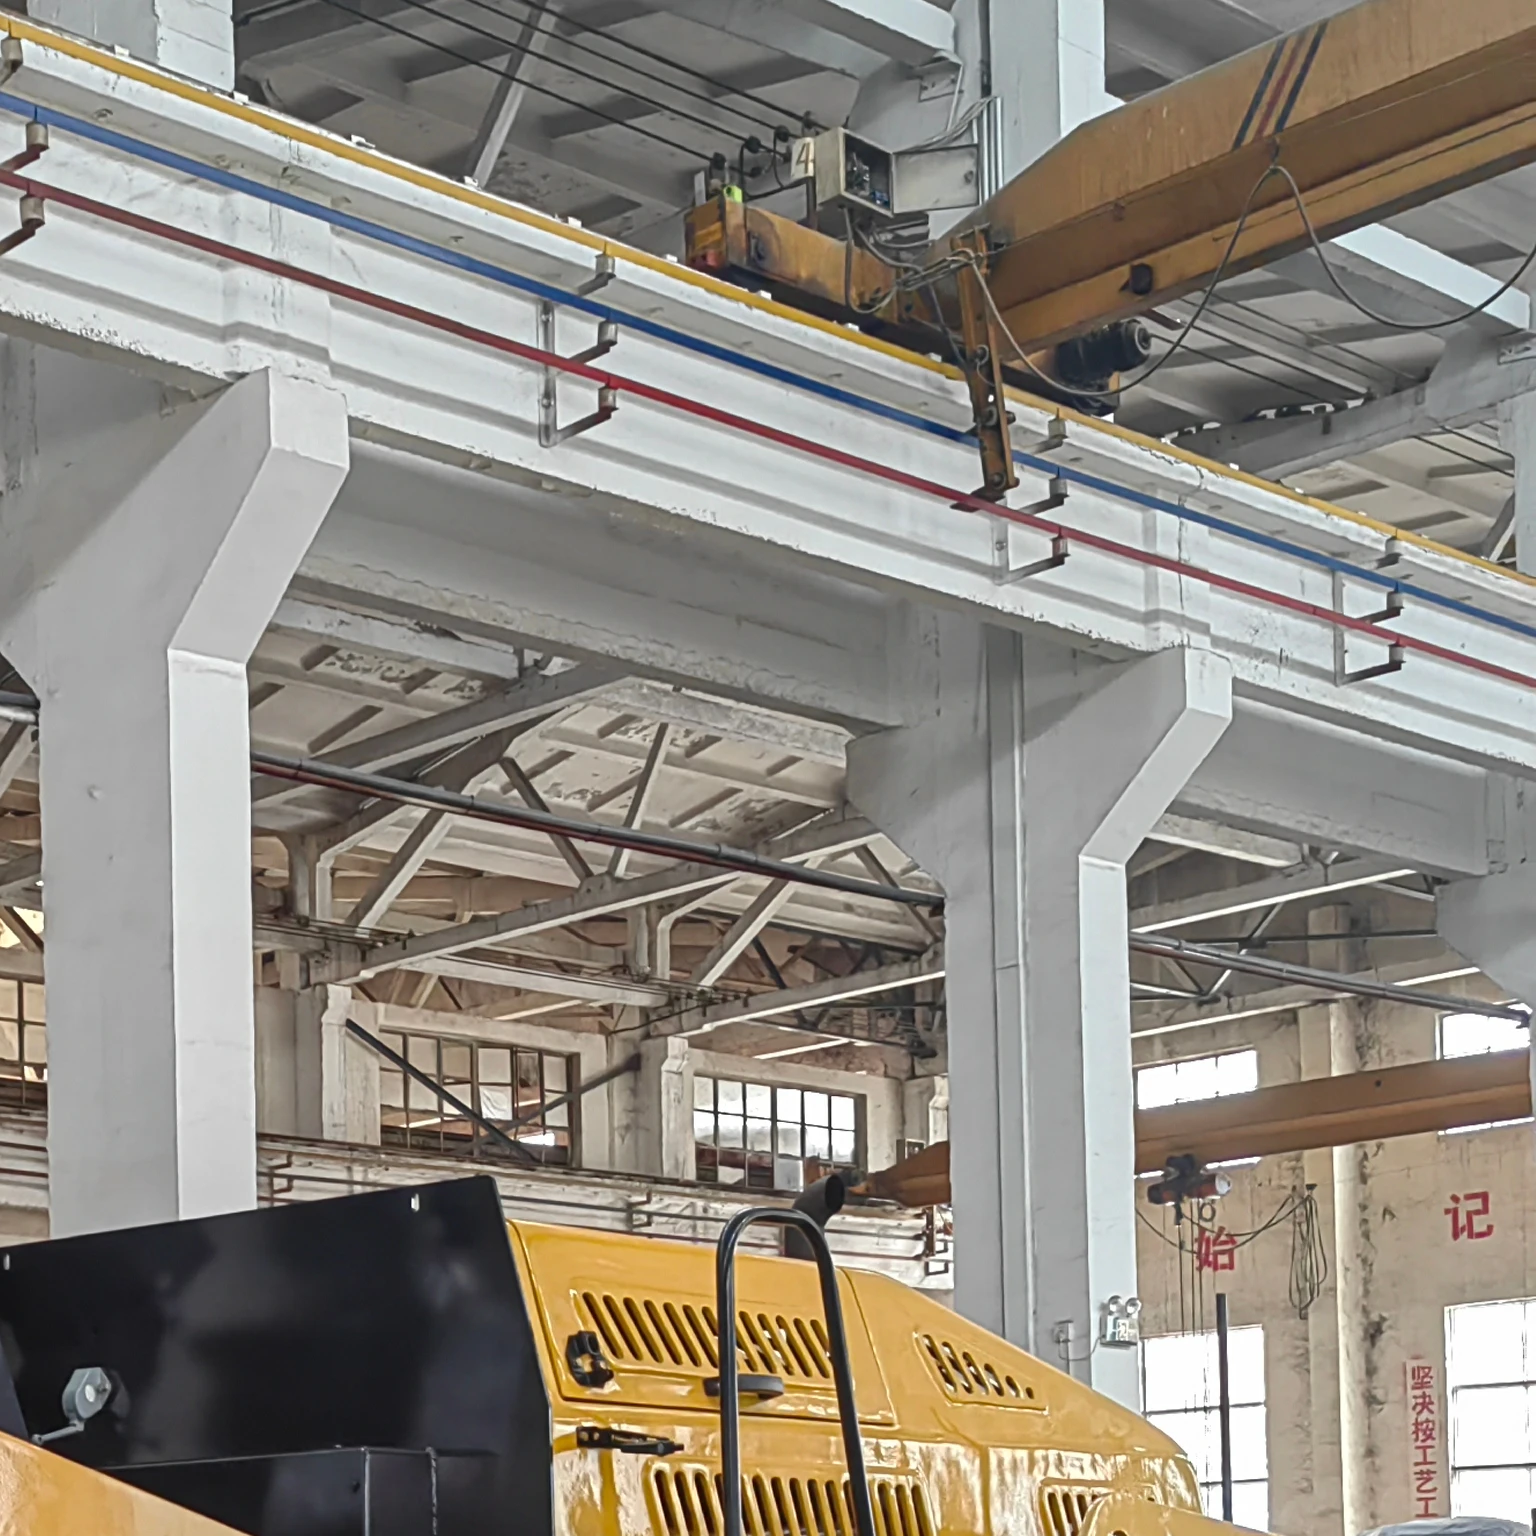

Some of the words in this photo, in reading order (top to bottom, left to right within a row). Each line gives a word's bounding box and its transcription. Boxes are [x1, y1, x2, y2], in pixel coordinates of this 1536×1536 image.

[796, 142, 814, 174] 4
[1444, 1191, 1494, 1241] 记
[1195, 1226, 1236, 1272] 始
[1411, 1366, 1438, 1518] 坚决按工艺工
